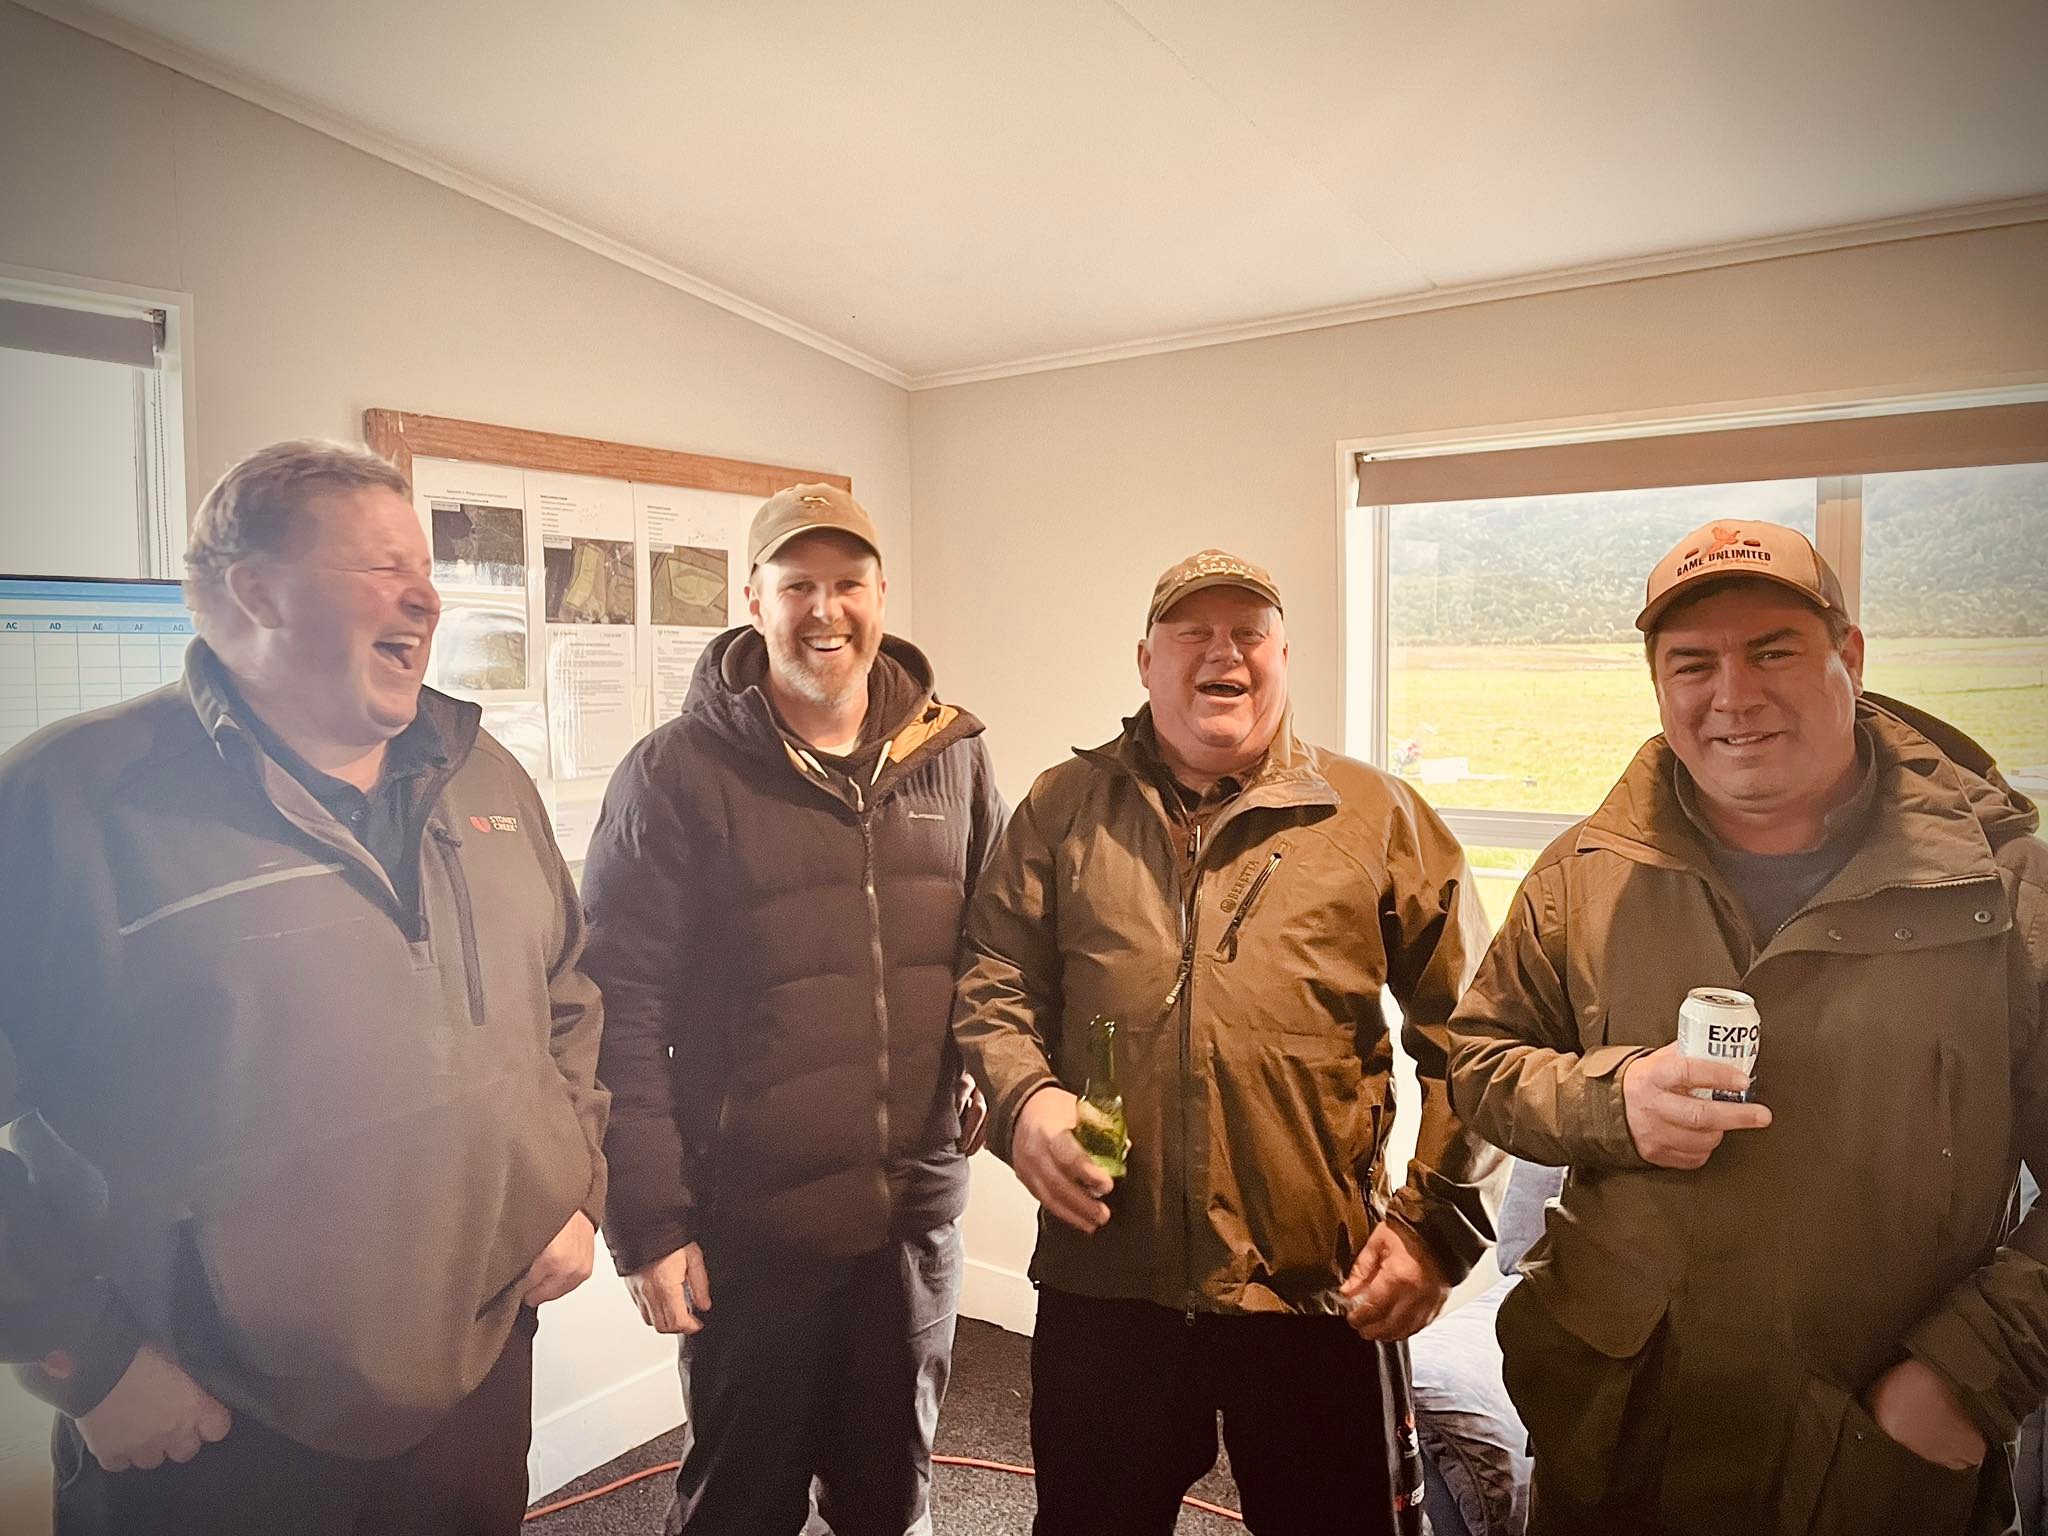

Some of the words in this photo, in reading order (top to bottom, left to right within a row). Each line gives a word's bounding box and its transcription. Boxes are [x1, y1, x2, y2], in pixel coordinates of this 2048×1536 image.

[1676, 557, 1705, 577] GAME
[1708, 549, 1771, 562] UNLIMITED
[5, 622, 18, 630] AC
[49, 622, 62, 630] AD
[92, 623, 104, 631] AE
[134, 623, 144, 631] AF
[1227, 861, 1259, 900] BERETTA
[1709, 1025, 1759, 1043] EXPO
